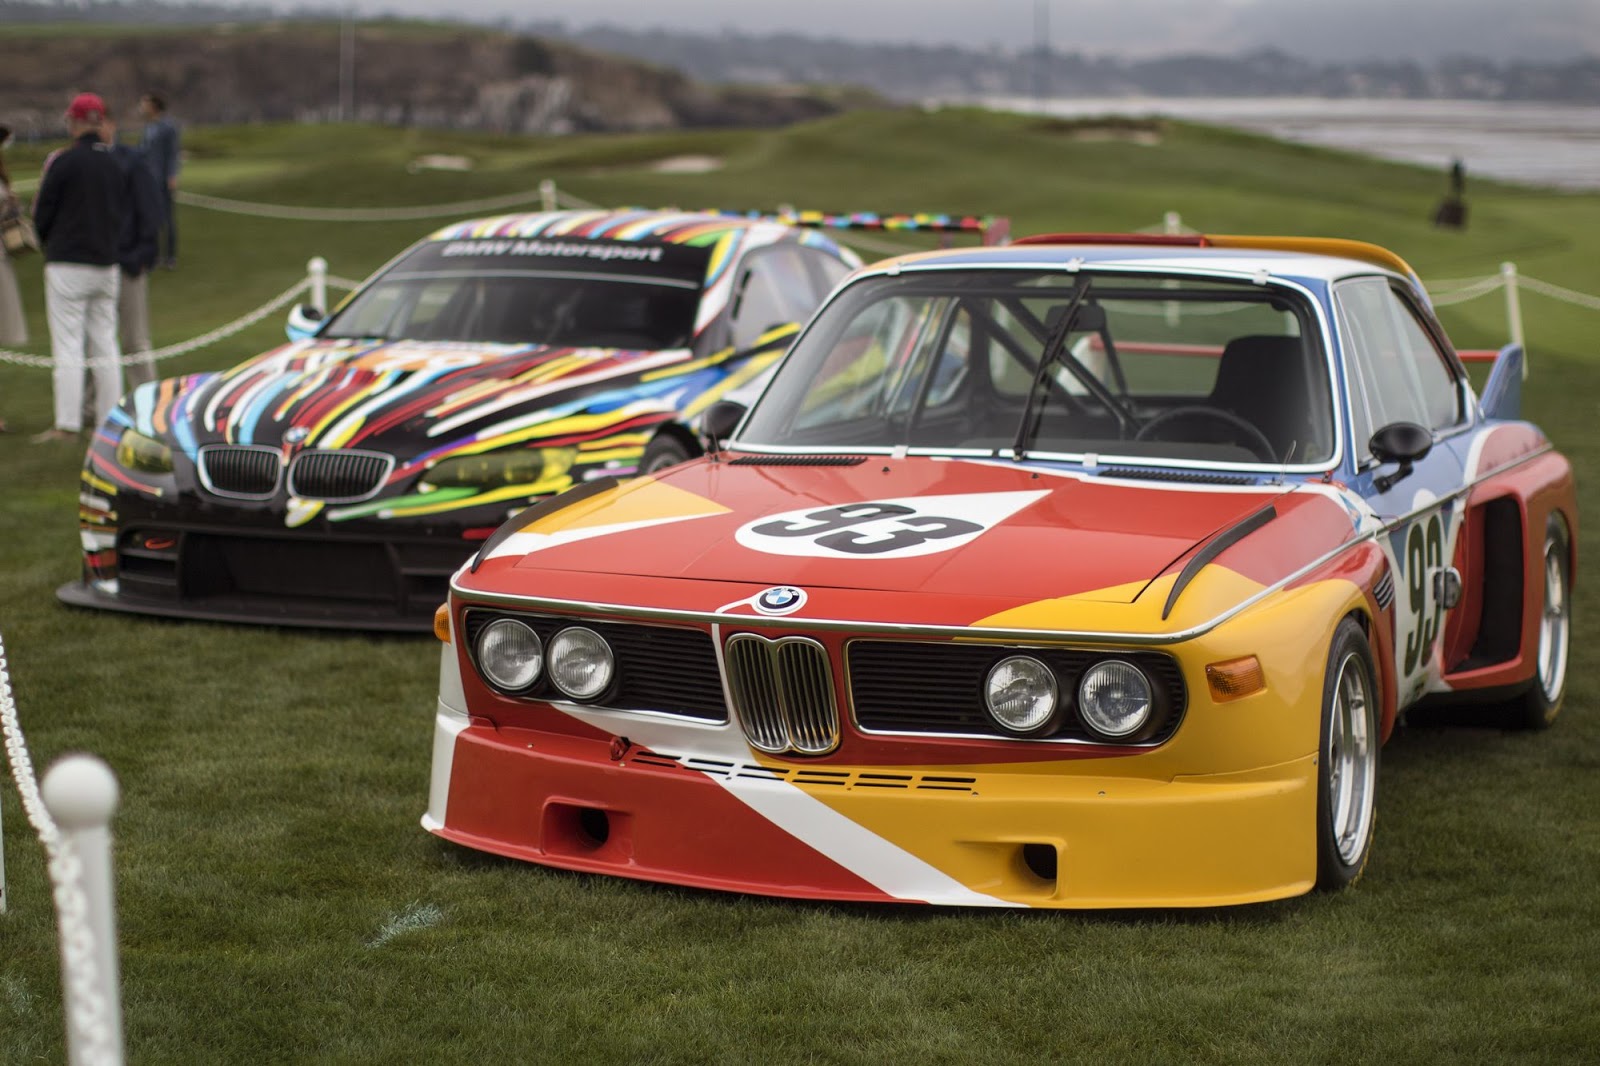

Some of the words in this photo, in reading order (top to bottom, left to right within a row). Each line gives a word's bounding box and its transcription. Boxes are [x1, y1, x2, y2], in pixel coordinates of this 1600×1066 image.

[442, 241, 511, 257] BMW
[511, 241, 663, 262] Motorsport
[751, 503, 985, 554] 93
[1404, 514, 1443, 677] 93
